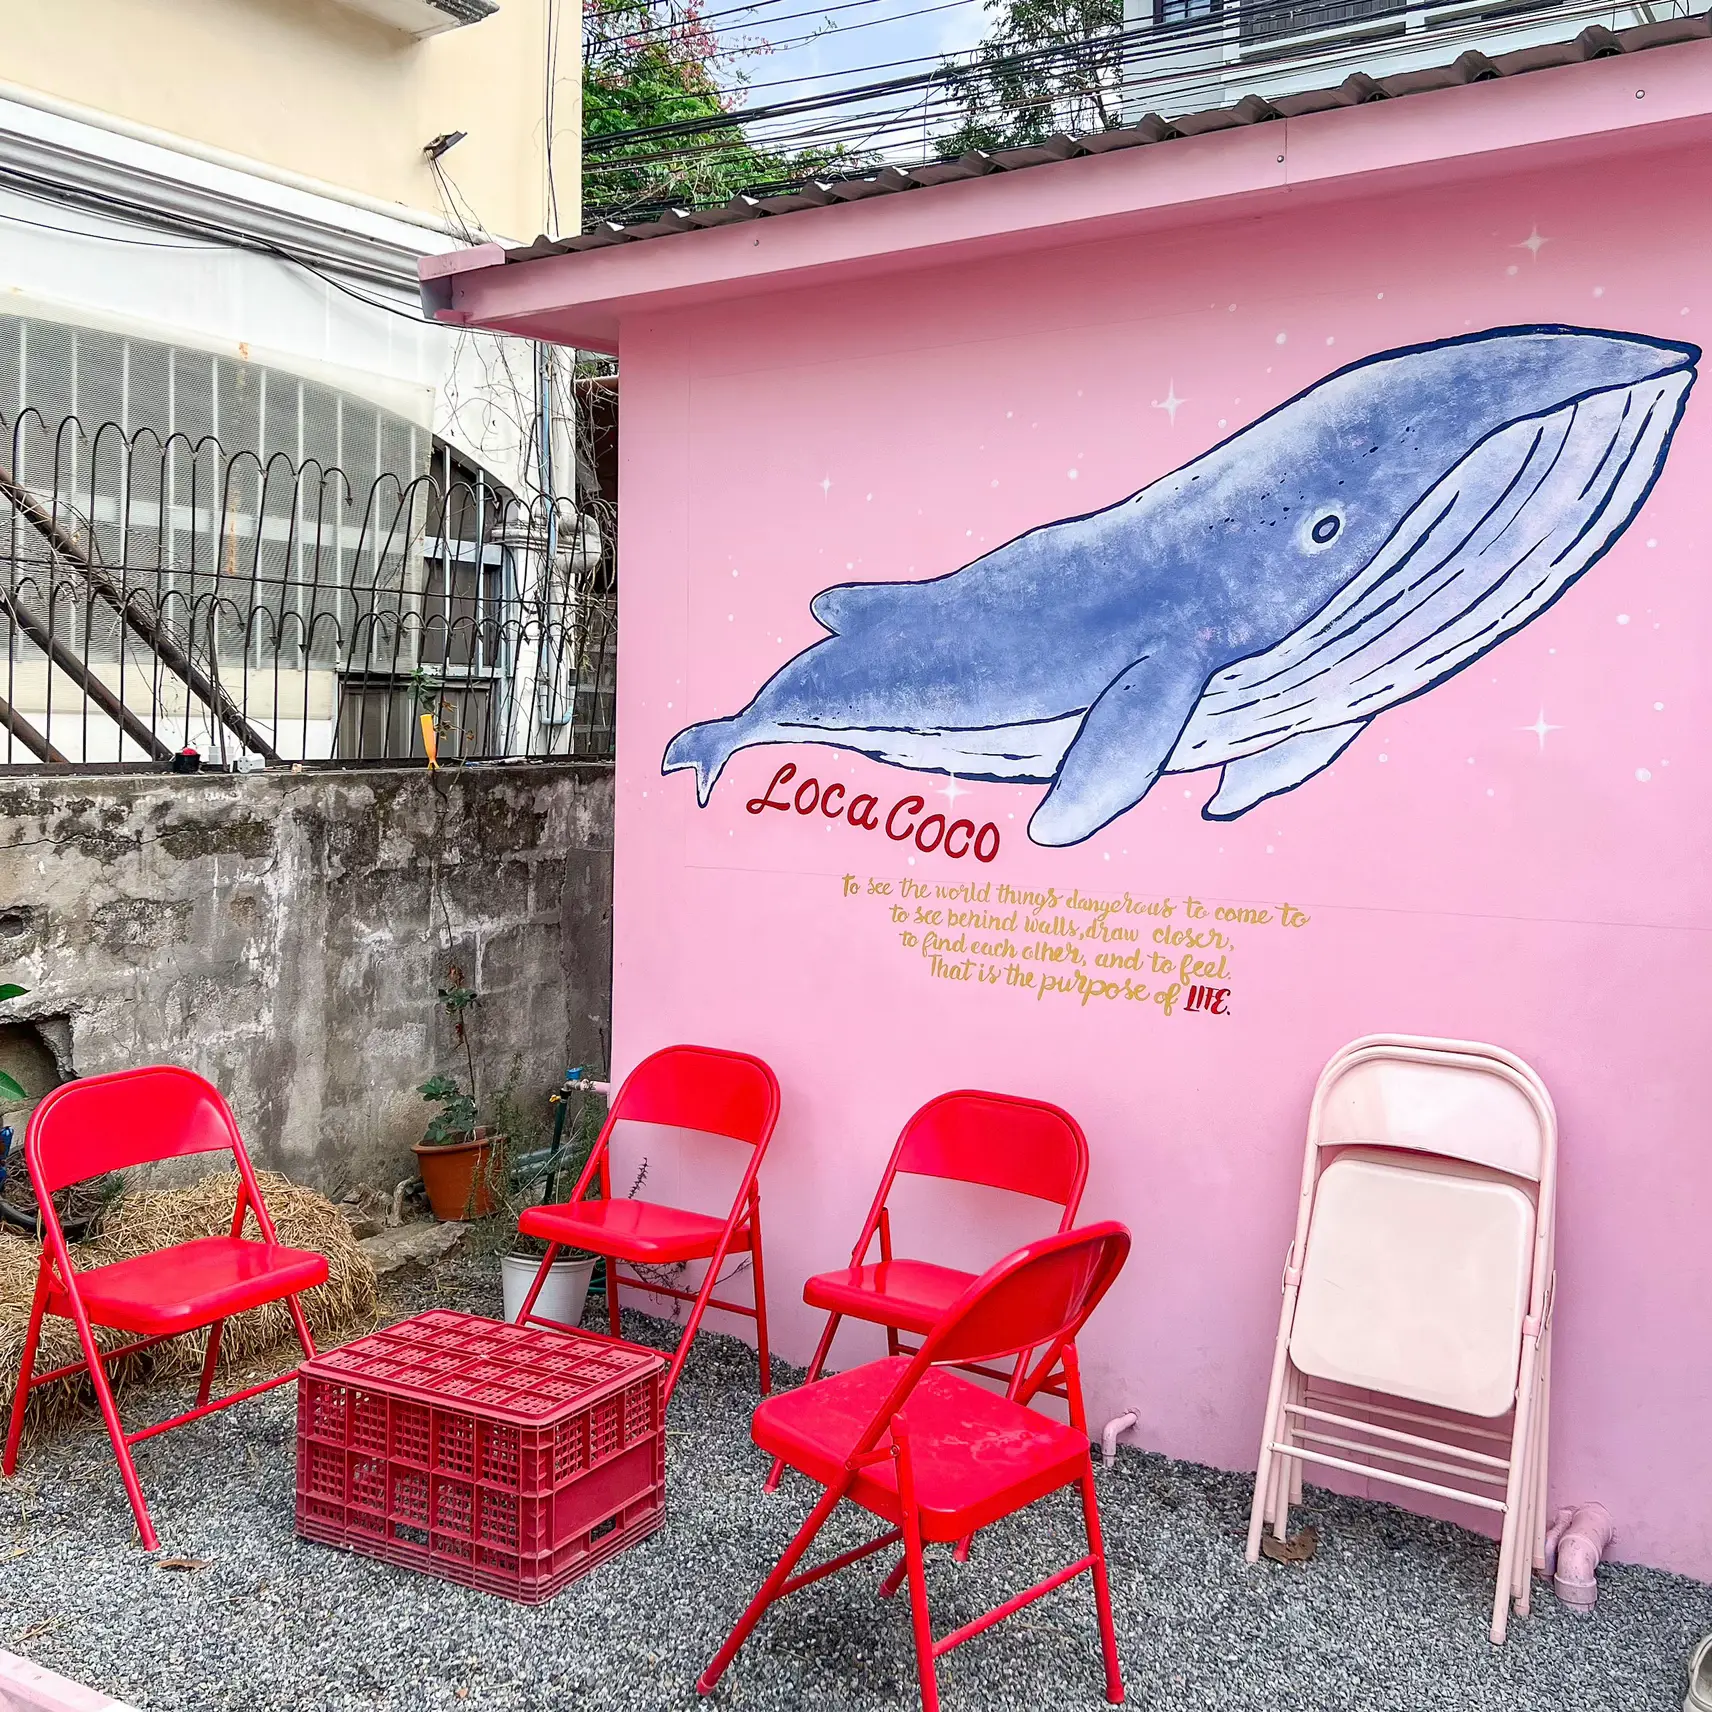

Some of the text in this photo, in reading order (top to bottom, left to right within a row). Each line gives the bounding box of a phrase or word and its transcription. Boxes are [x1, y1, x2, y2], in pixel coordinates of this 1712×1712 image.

[746, 762, 879, 831] Loca
[867, 877, 894, 897] see
[898, 877, 931, 899] the
[935, 881, 991, 905] world
[996, 883, 1063, 916] things
[1066, 889, 1177, 921] dangerous
[1183, 896, 1210, 920] to
[1214, 905, 1274, 925] come
[1275, 902, 1311, 928] to
[889, 904, 910, 924] to
[913, 906, 943, 926] see
[947, 908, 1018, 932] behind
[1085, 917, 1139, 943] draw
[1152, 924, 1235, 952] closer,
[899, 930, 920, 948] to
[921, 931, 967, 958] find
[970, 938, 1018, 959] each
[1094, 947, 1144, 972] and
[1146, 951, 1176, 974] to
[1179, 953, 1232, 986] feel.
[928, 954, 977, 981] That
[977, 963, 1002, 985] is
[1004, 962, 1038, 989] the
[1037, 969, 1150, 1007] purpose
[1152, 982, 1183, 1017] of
